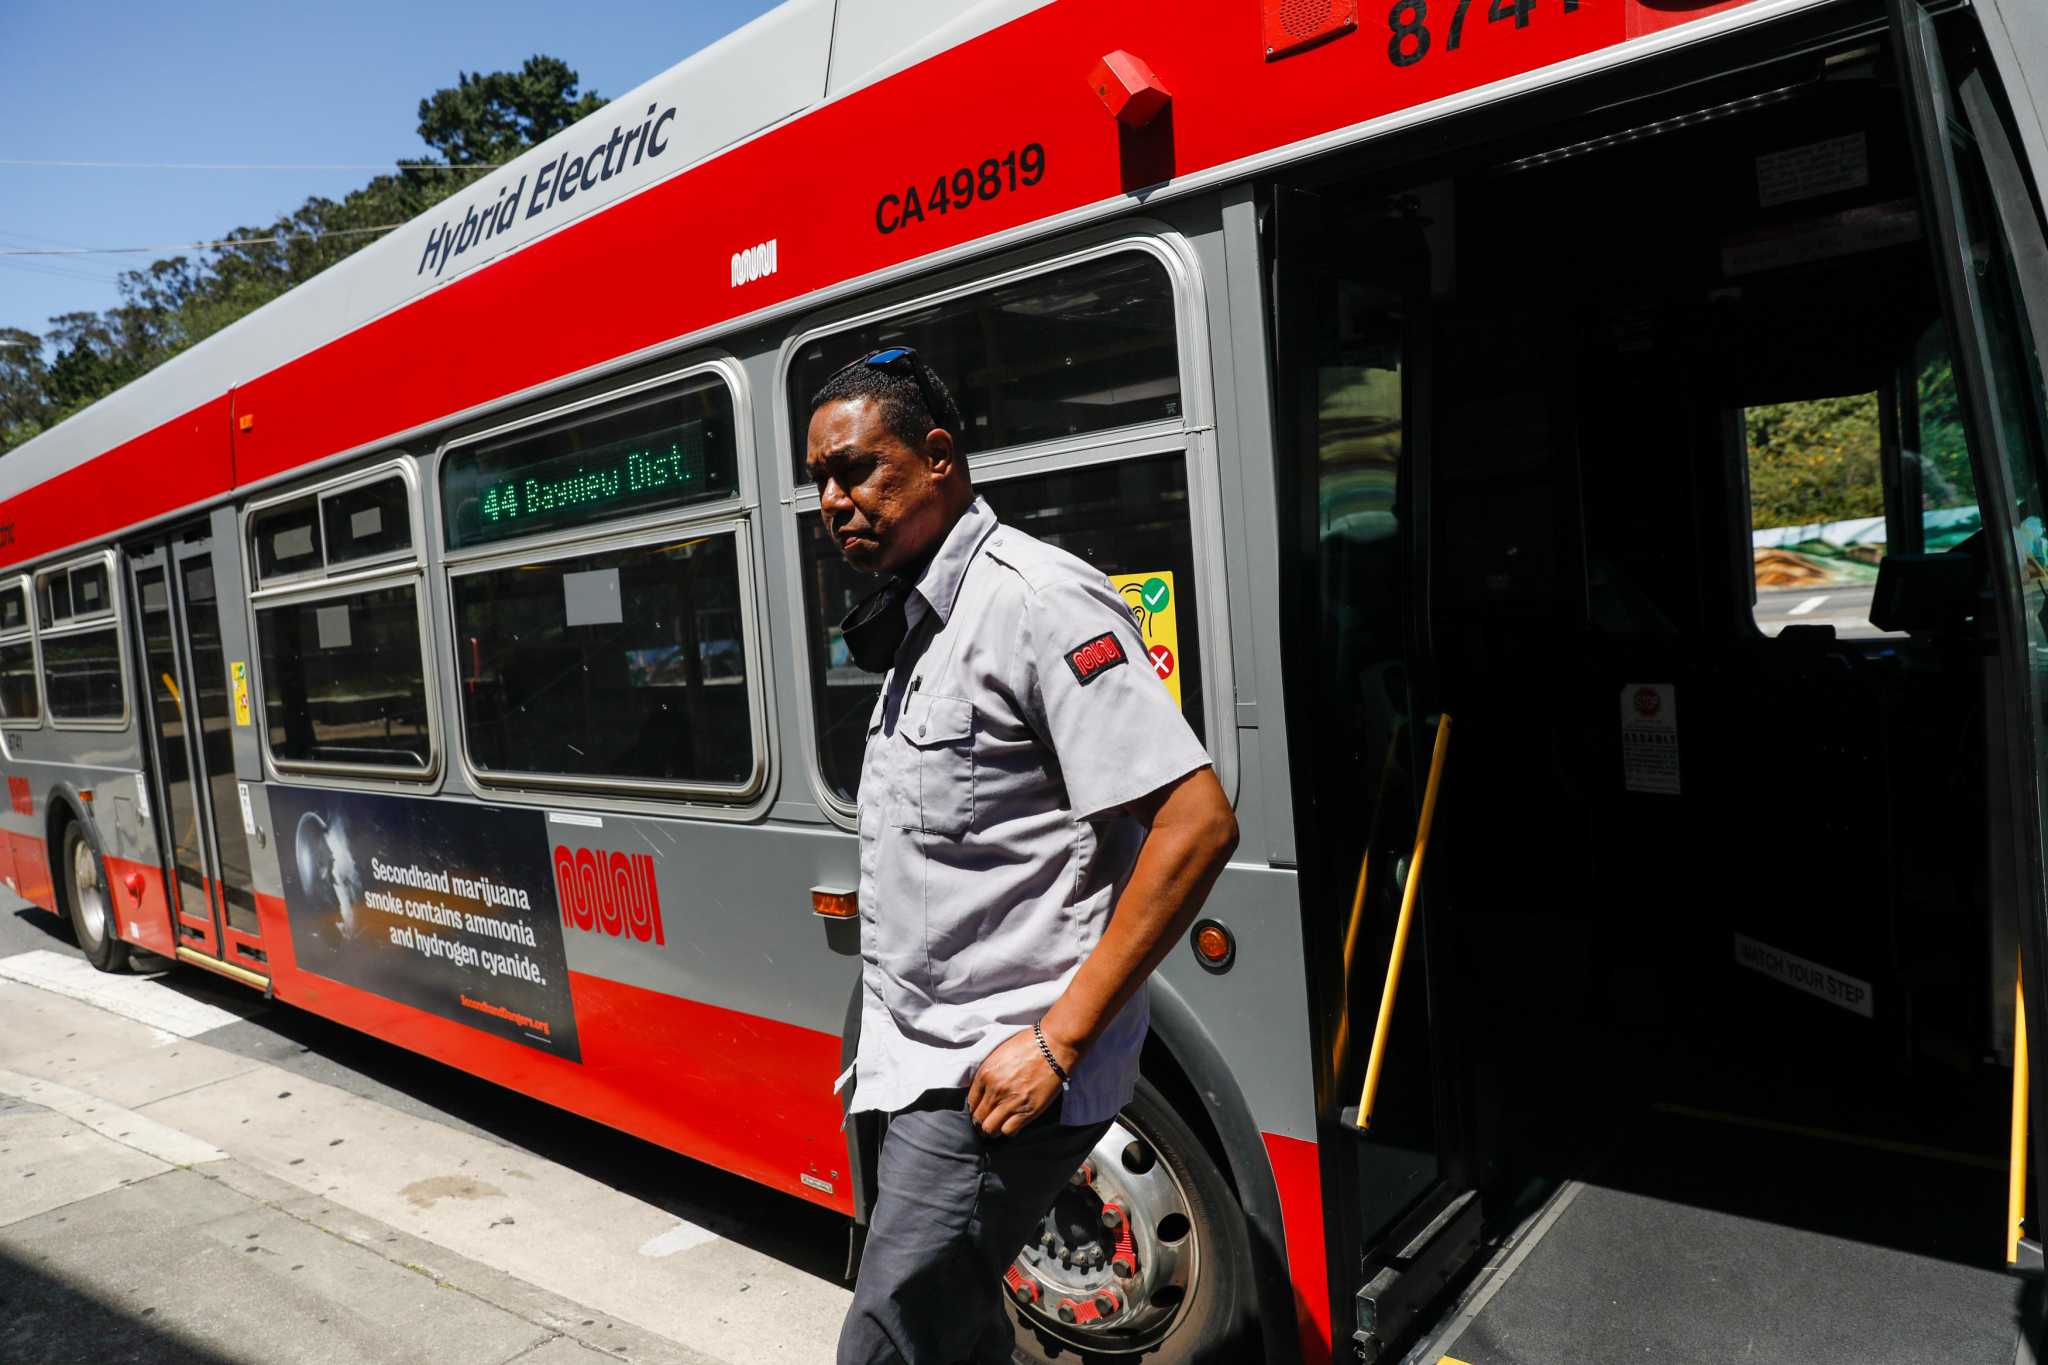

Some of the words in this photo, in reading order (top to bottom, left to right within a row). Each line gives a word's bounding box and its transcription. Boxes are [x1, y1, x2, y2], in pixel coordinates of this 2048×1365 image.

[417, 174, 528, 278] Hybrid
[525, 102, 677, 220] Electric
[875, 142, 1045, 234] CA49819
[484, 484, 518, 520] 44
[526, 467, 619, 513] Bayview
[629, 445, 691, 491] Dist.
[371, 857, 450, 894] Secondhand
[452, 876, 531, 911] marijuana
[364, 890, 404, 915] smoke
[405, 901, 463, 931] contains
[465, 913, 537, 947] ammonia
[389, 925, 414, 949] and
[414, 927, 480, 967] hydrogen
[481, 951, 547, 986] cyanide.
[1742, 943, 1785, 973] WATCH
[1786, 959, 1825, 990] YOUR
[1827, 975, 1865, 1005] STEP
